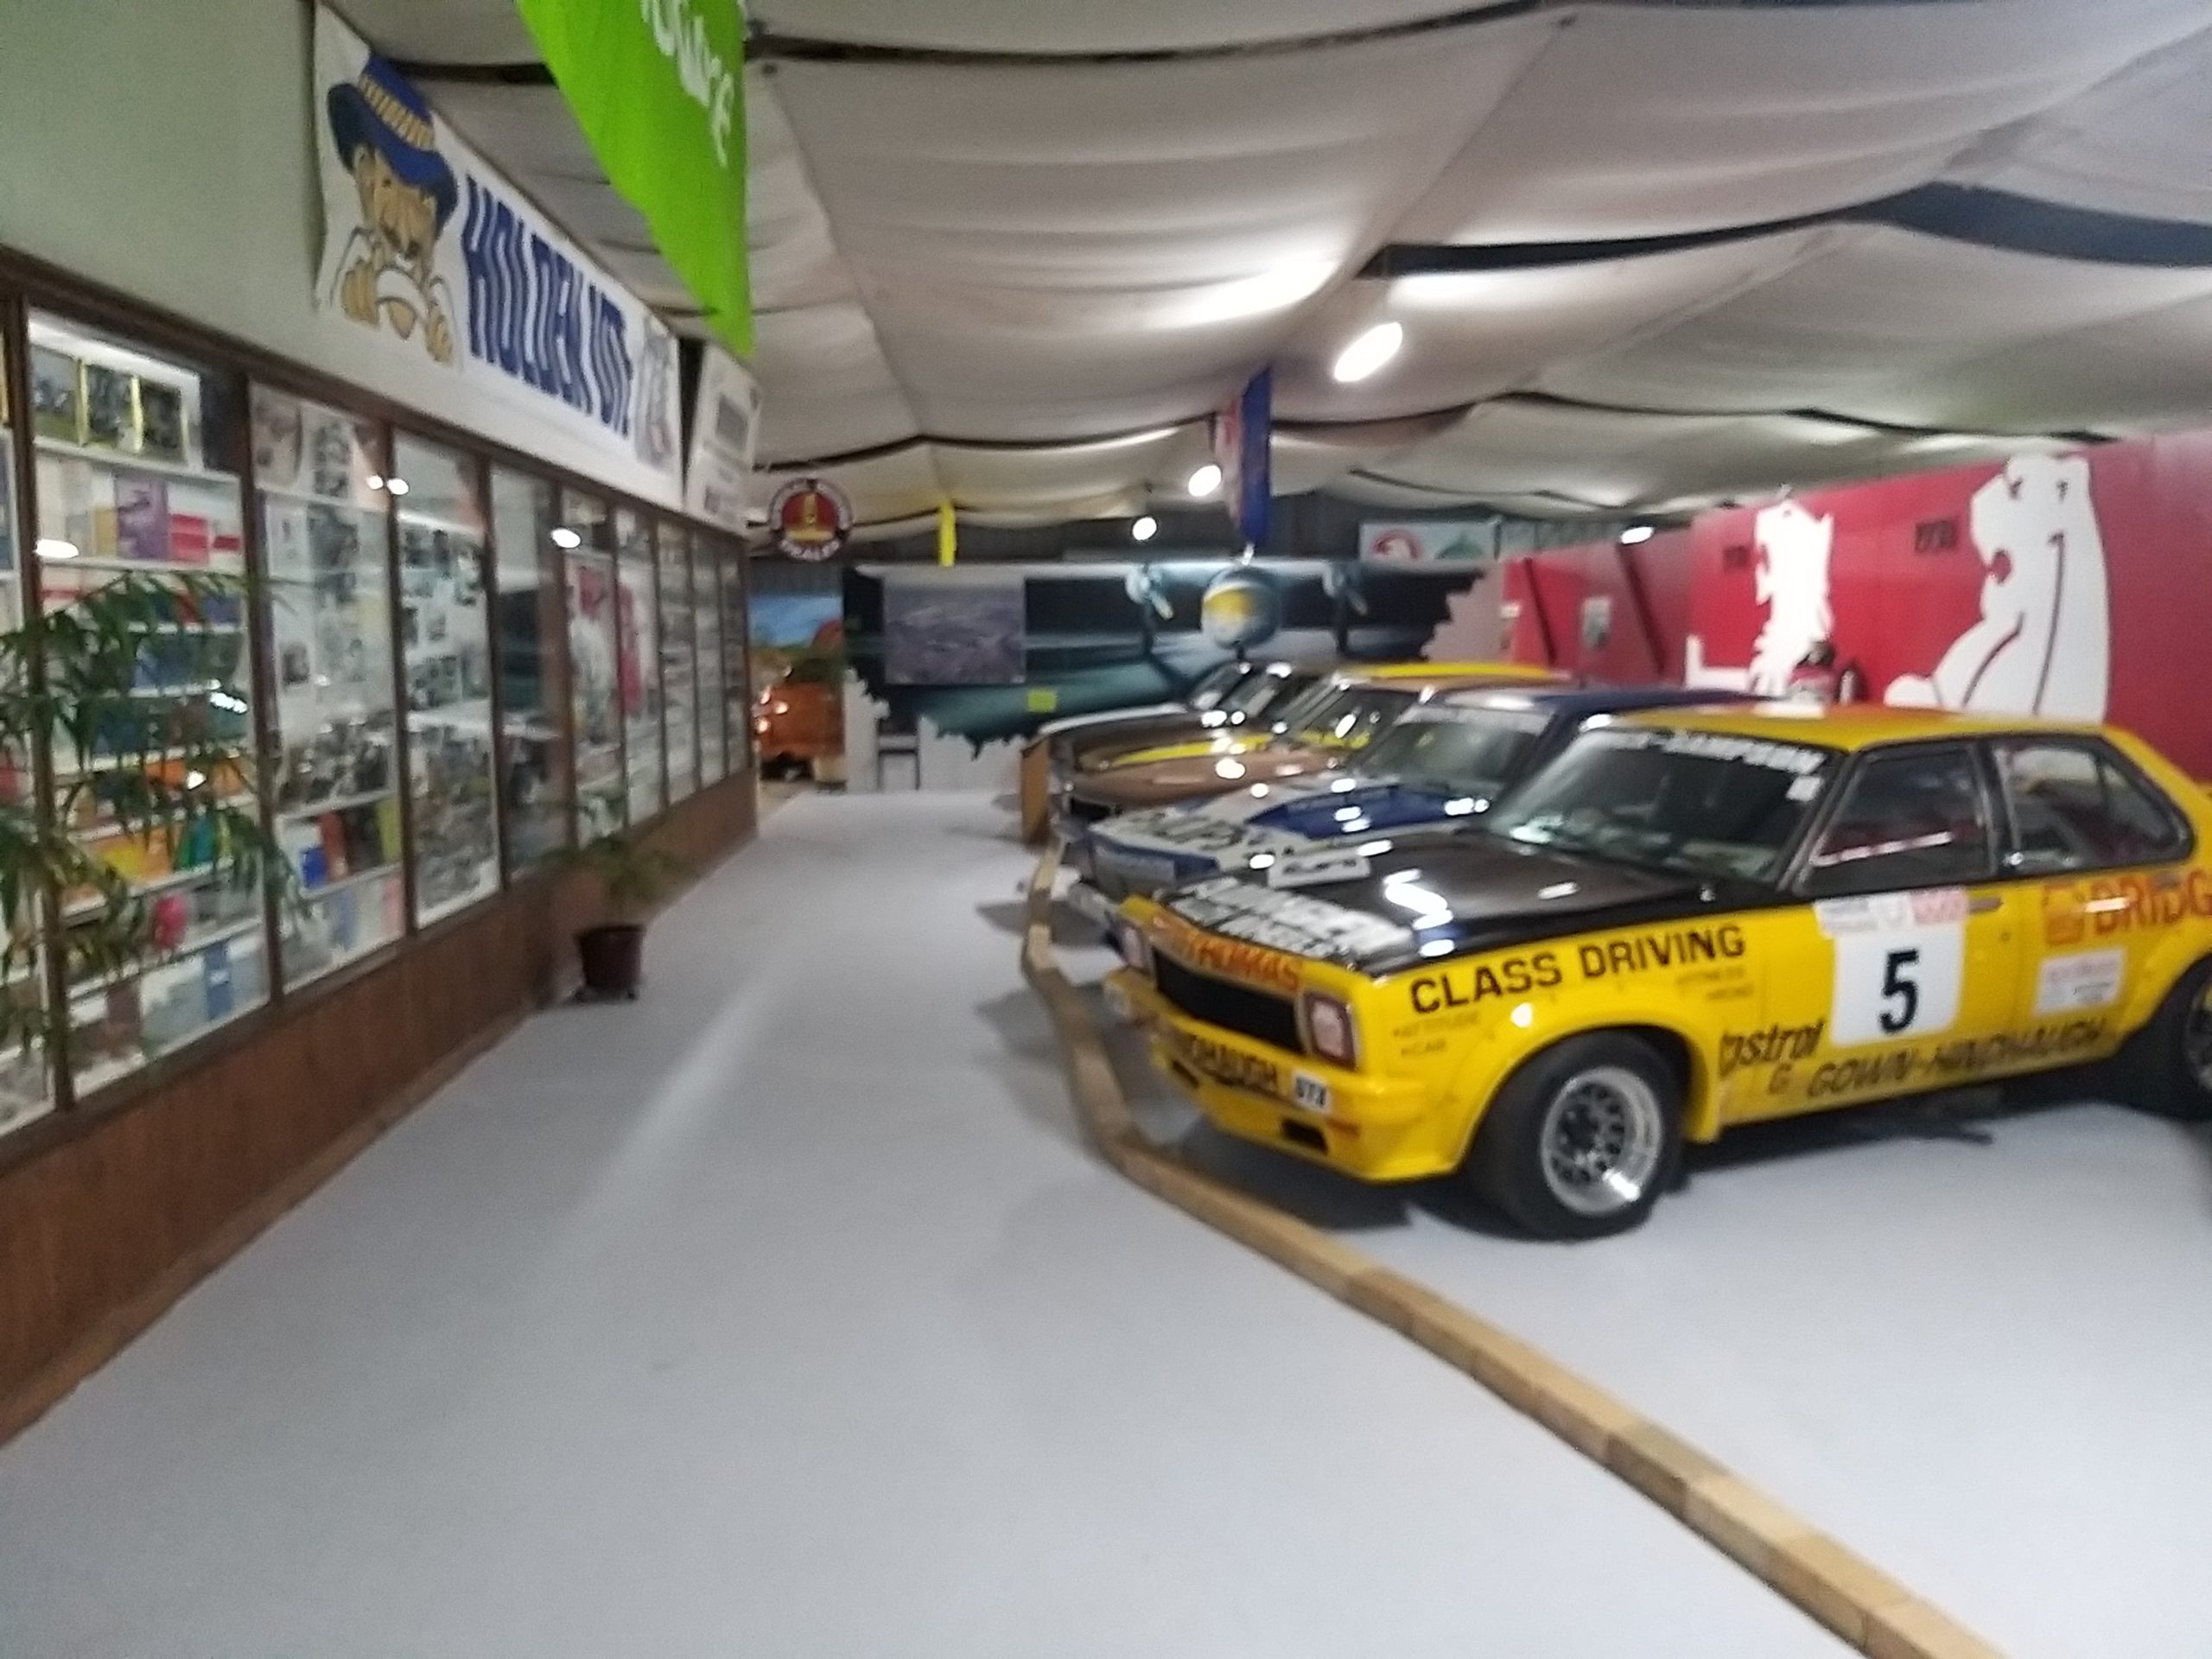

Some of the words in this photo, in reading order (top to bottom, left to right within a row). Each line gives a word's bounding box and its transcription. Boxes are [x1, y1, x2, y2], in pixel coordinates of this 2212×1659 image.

[462, 173, 593, 416] HOLDEN
[1409, 950, 1563, 1015] CLASS
[1578, 925, 1746, 980] DRIVING
[1879, 948, 1920, 1033] 5
